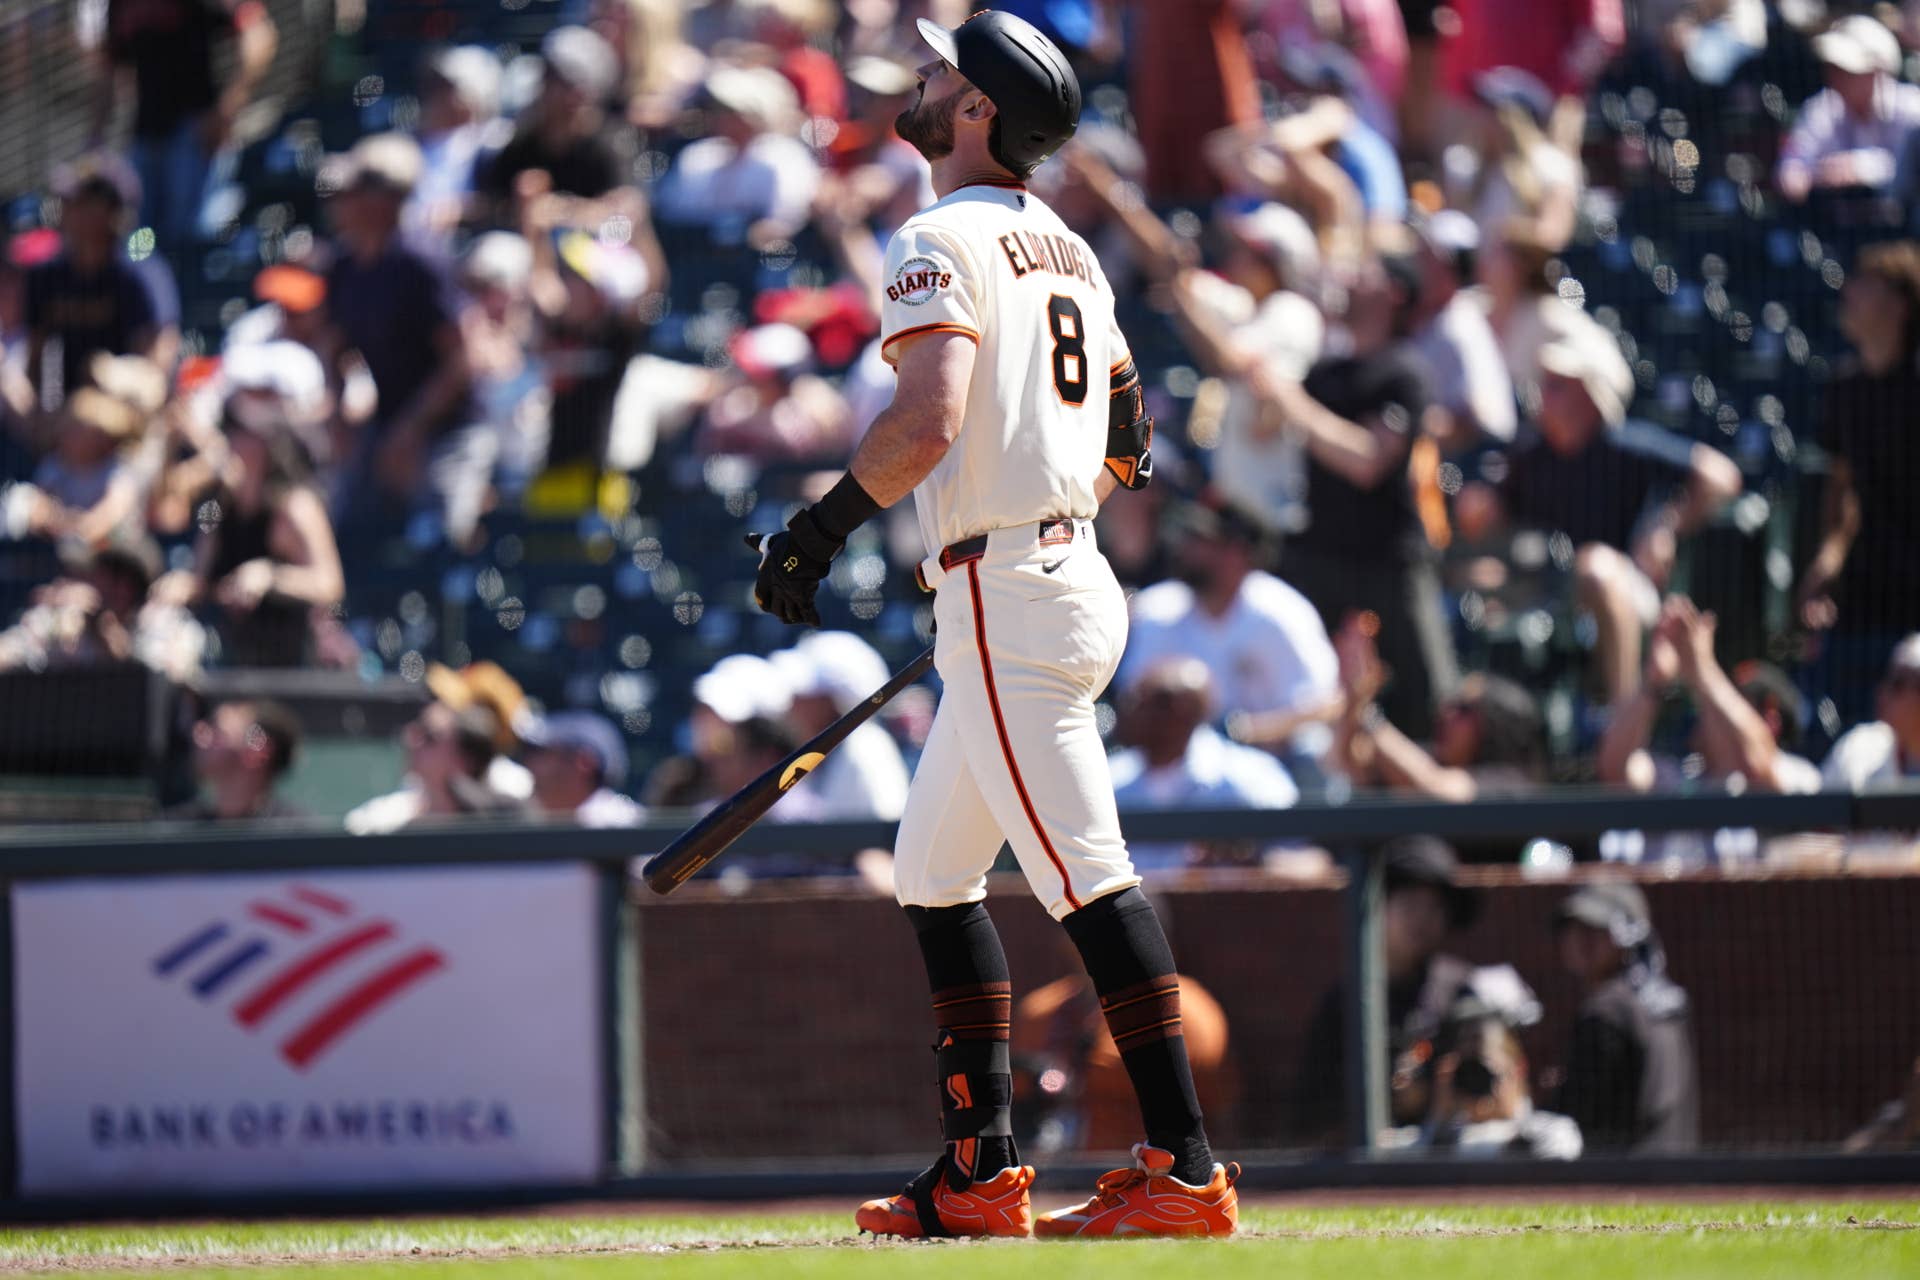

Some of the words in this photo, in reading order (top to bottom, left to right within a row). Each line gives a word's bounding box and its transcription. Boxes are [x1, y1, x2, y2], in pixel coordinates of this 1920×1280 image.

[886, 271, 952, 302] GIANTS
[1047, 292, 1088, 407] 8
[90, 1103, 218, 1149] BANK
[227, 1102, 287, 1147] OF
[299, 1101, 515, 1146] AMERICA
